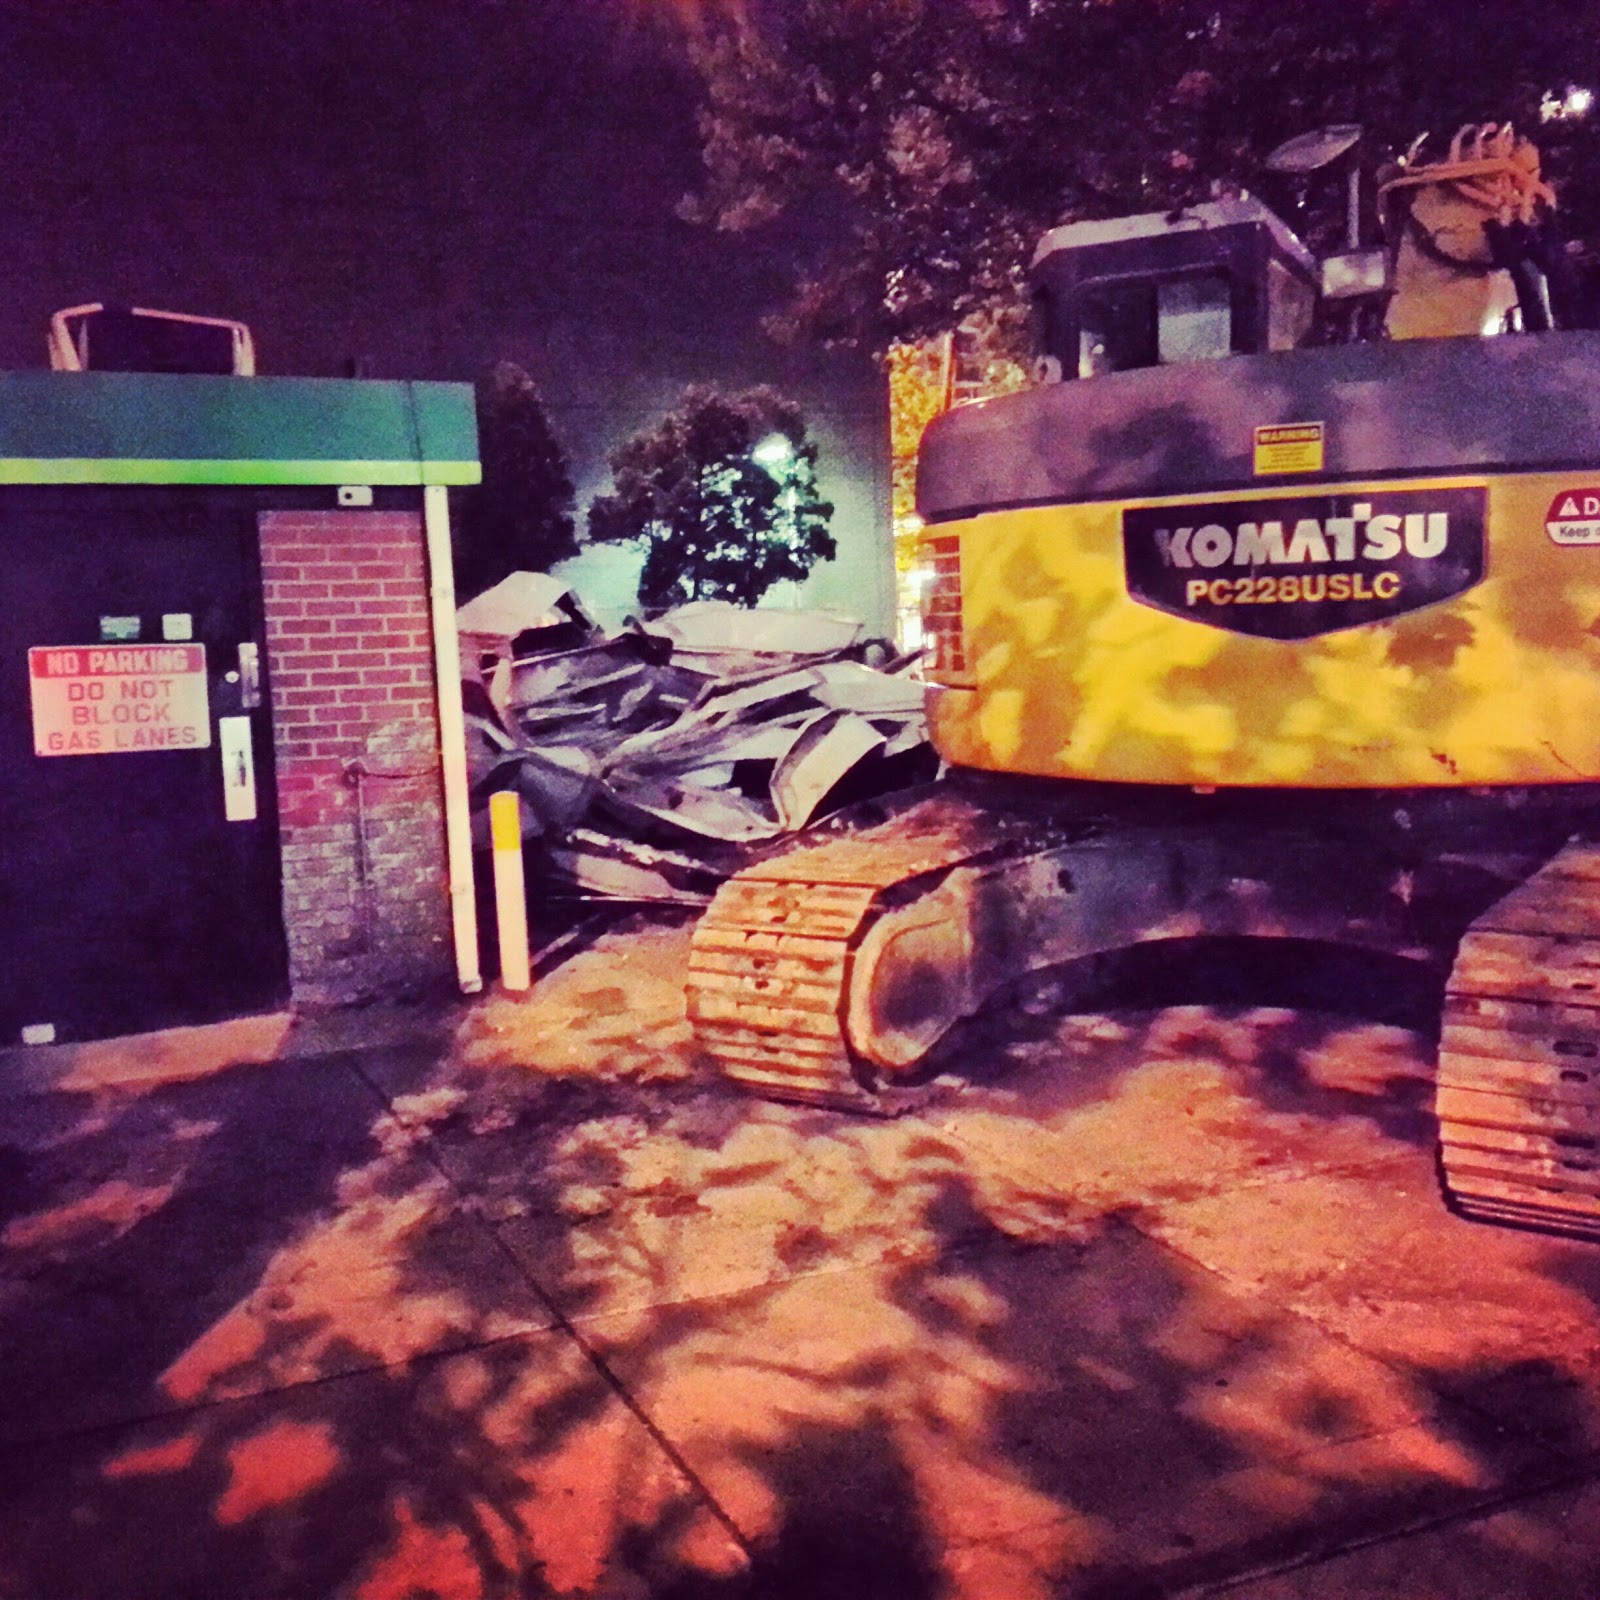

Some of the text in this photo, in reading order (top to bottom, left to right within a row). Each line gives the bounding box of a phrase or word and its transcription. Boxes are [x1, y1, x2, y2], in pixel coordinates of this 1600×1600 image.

[1260, 428, 1319, 443] WARNING
[1154, 504, 1448, 568] KOMATSU
[1560, 526, 1590, 539] Keep
[1186, 572, 1400, 606] PC228USLC
[47, 649, 189, 674] NO PARKING
[67, 680, 174, 702] DO NOT
[72, 703, 171, 725] BLOCK
[48, 726, 197, 751] GAS LANES
